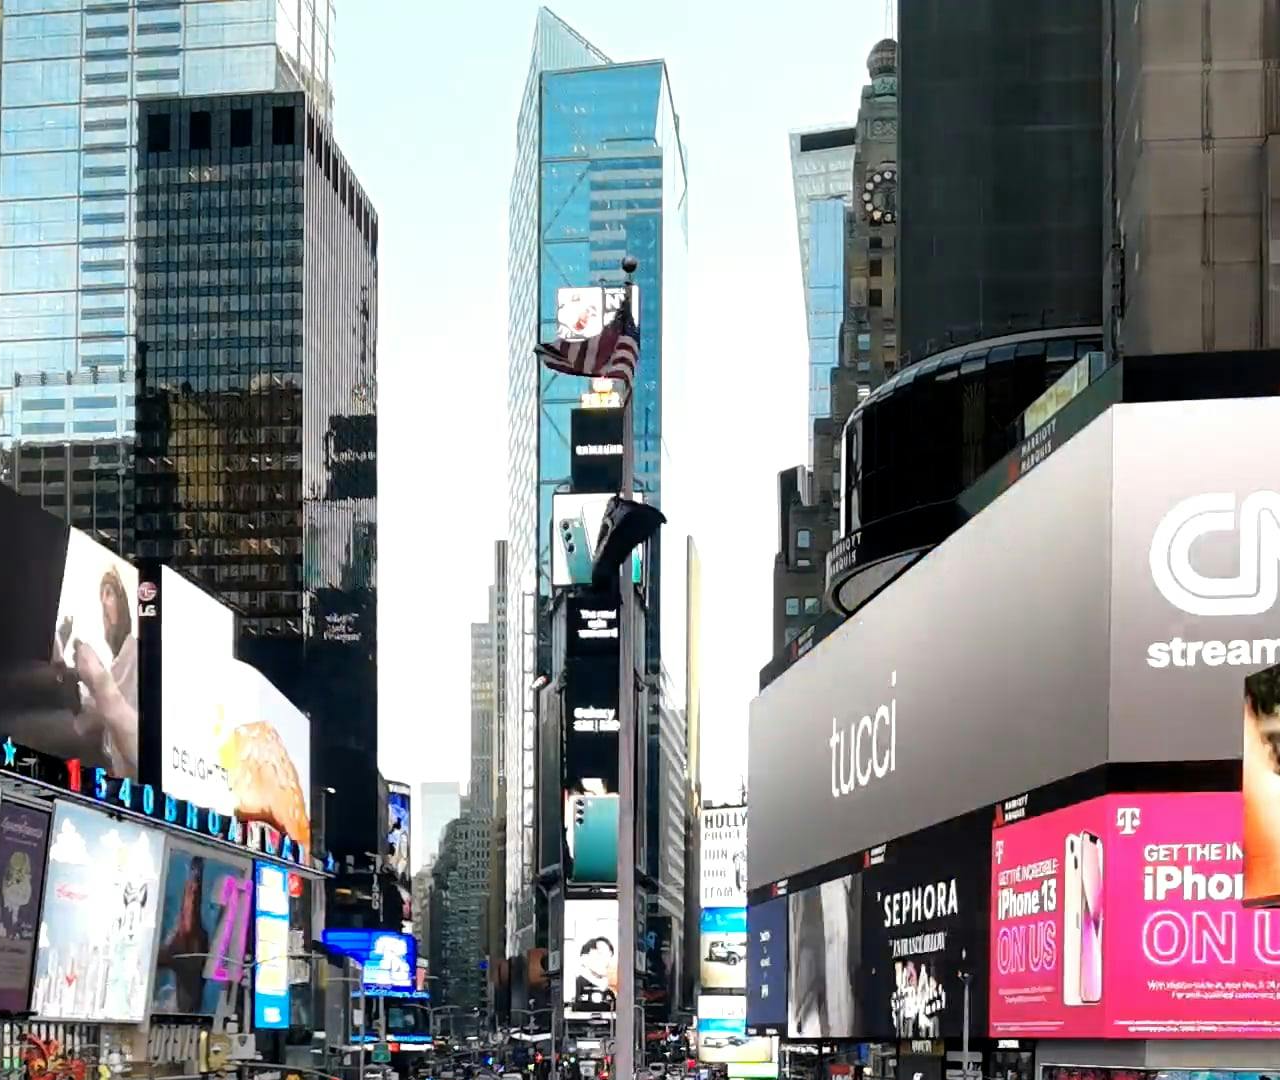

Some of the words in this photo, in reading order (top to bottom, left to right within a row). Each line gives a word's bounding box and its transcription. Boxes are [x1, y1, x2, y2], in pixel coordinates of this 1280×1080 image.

[138, 603, 157, 617] LG
[829, 672, 897, 798] tucci
[1144, 845, 1178, 861] GET
[1183, 844, 1221, 860] THE
[883, 878, 958, 928] SEPHORA
[998, 886, 1040, 920] iPhone
[1042, 879, 1056, 912] 13
[997, 926, 1026, 975] ON
[1028, 920, 1056, 972] US
[1143, 912, 1236, 964] ON
